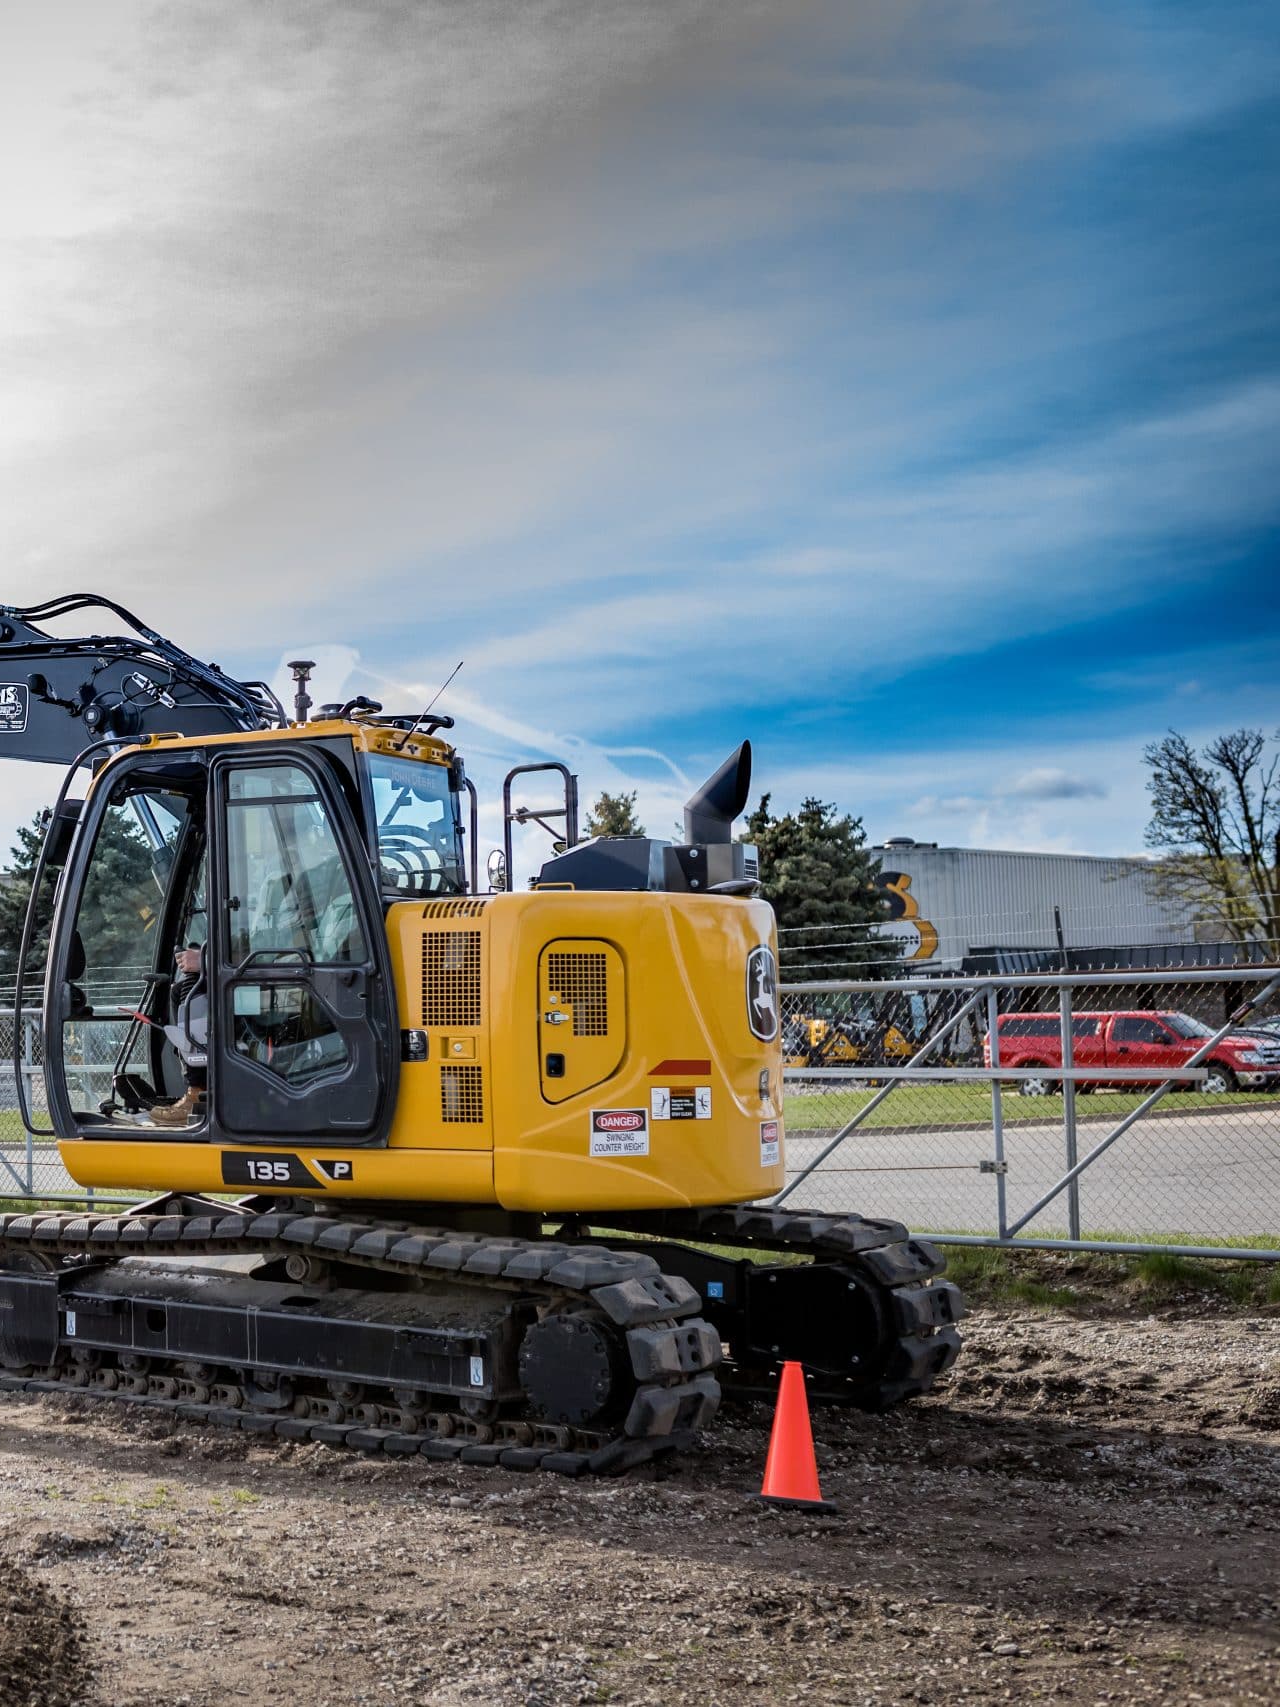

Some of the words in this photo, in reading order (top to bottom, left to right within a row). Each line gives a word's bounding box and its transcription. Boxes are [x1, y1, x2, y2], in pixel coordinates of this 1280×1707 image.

[600, 1117, 639, 1127] DANGER
[606, 1133, 635, 1142] SWINGING
[594, 1143, 622, 1152] COUNTER
[624, 1142, 645, 1151] WEIGHT
[247, 1161, 290, 1180] 135
[333, 1162, 350, 1178] P
